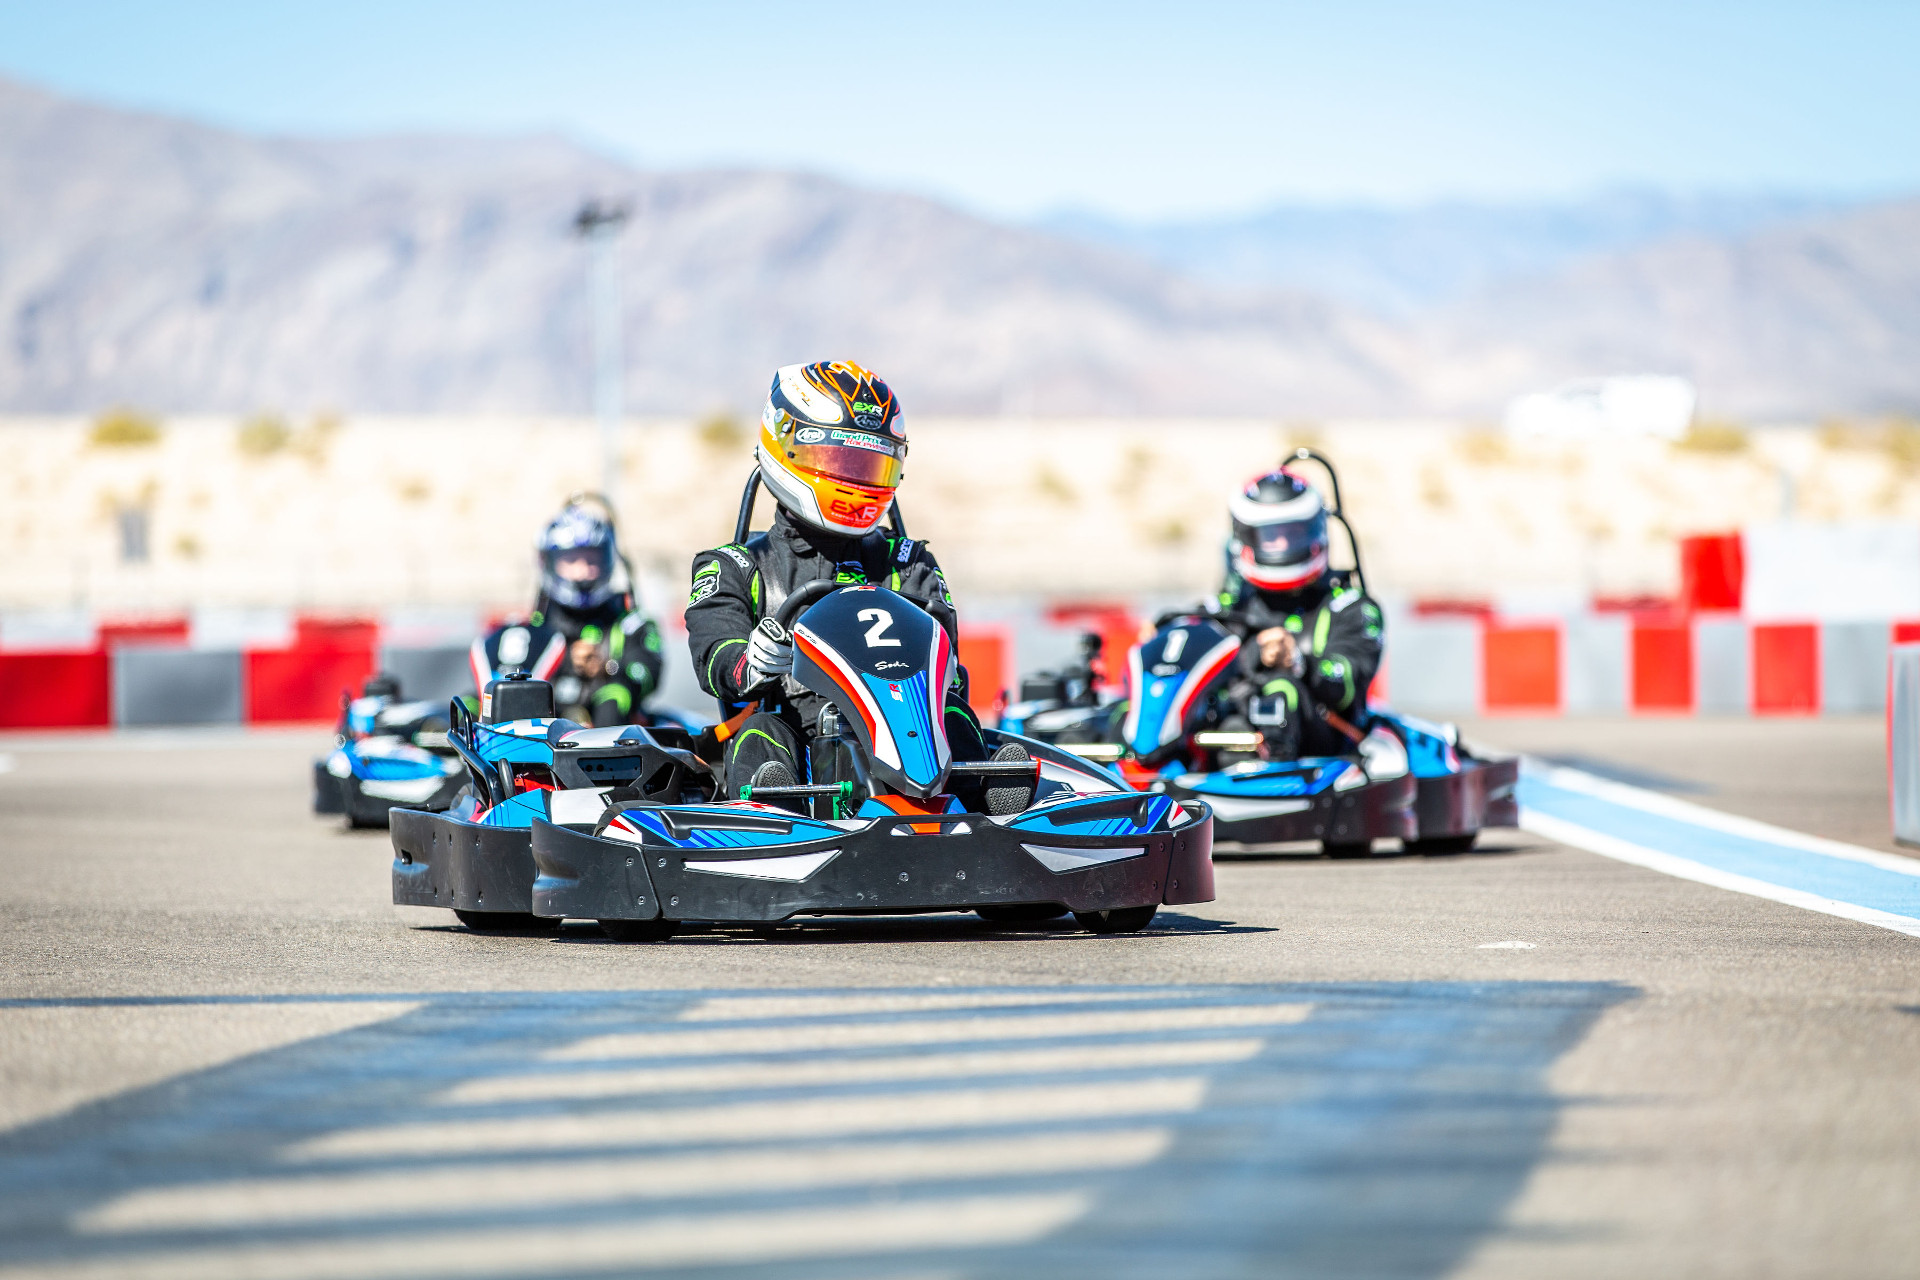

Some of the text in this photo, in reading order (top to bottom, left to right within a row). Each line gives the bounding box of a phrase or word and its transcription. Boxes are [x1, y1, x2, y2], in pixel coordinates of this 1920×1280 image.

[852, 401, 883, 416] EXR
[830, 499, 878, 519] EXR
[836, 571, 868, 585] EX
[857, 608, 902, 648] 2
[1162, 629, 1189, 663] 1
